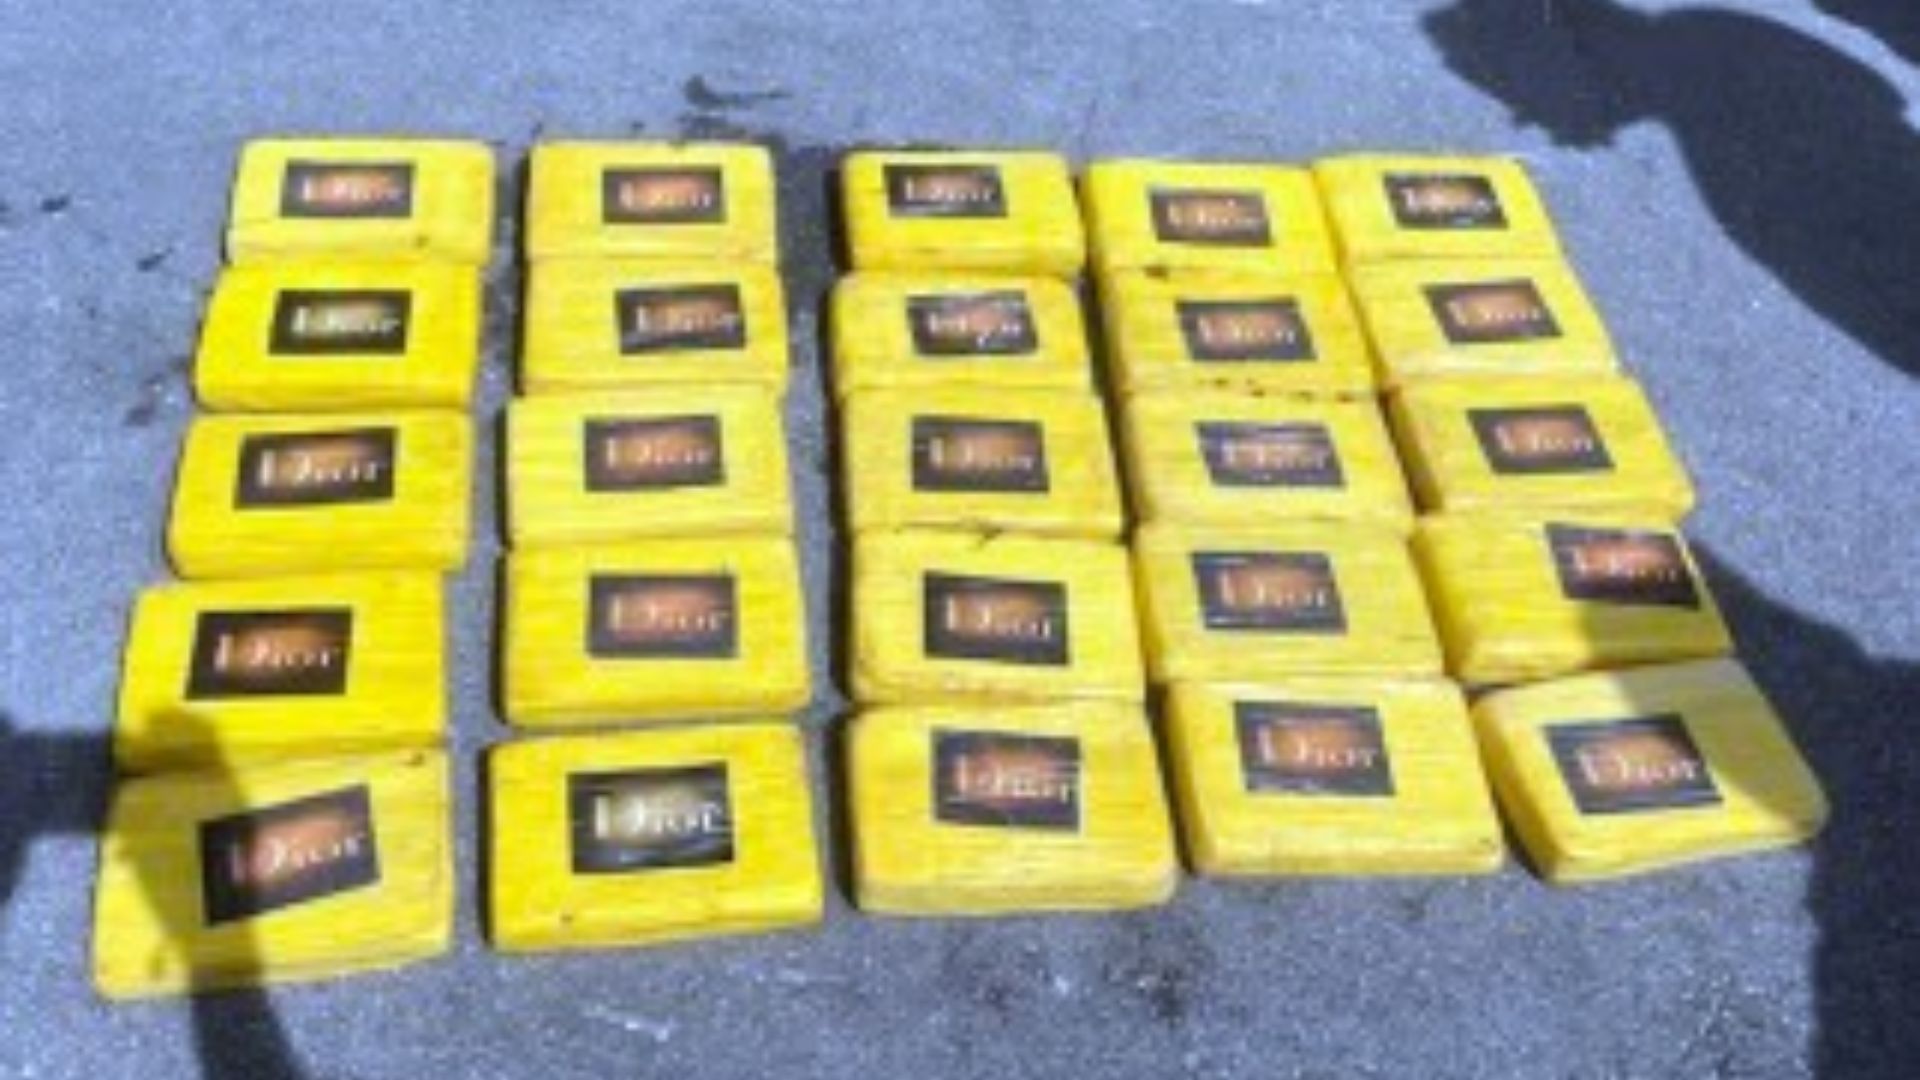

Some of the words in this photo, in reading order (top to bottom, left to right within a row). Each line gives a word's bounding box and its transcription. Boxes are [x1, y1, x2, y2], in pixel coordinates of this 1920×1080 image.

[257, 447, 390, 487] Dior
[213, 632, 342, 672] Dior
[594, 792, 726, 842] Dior
